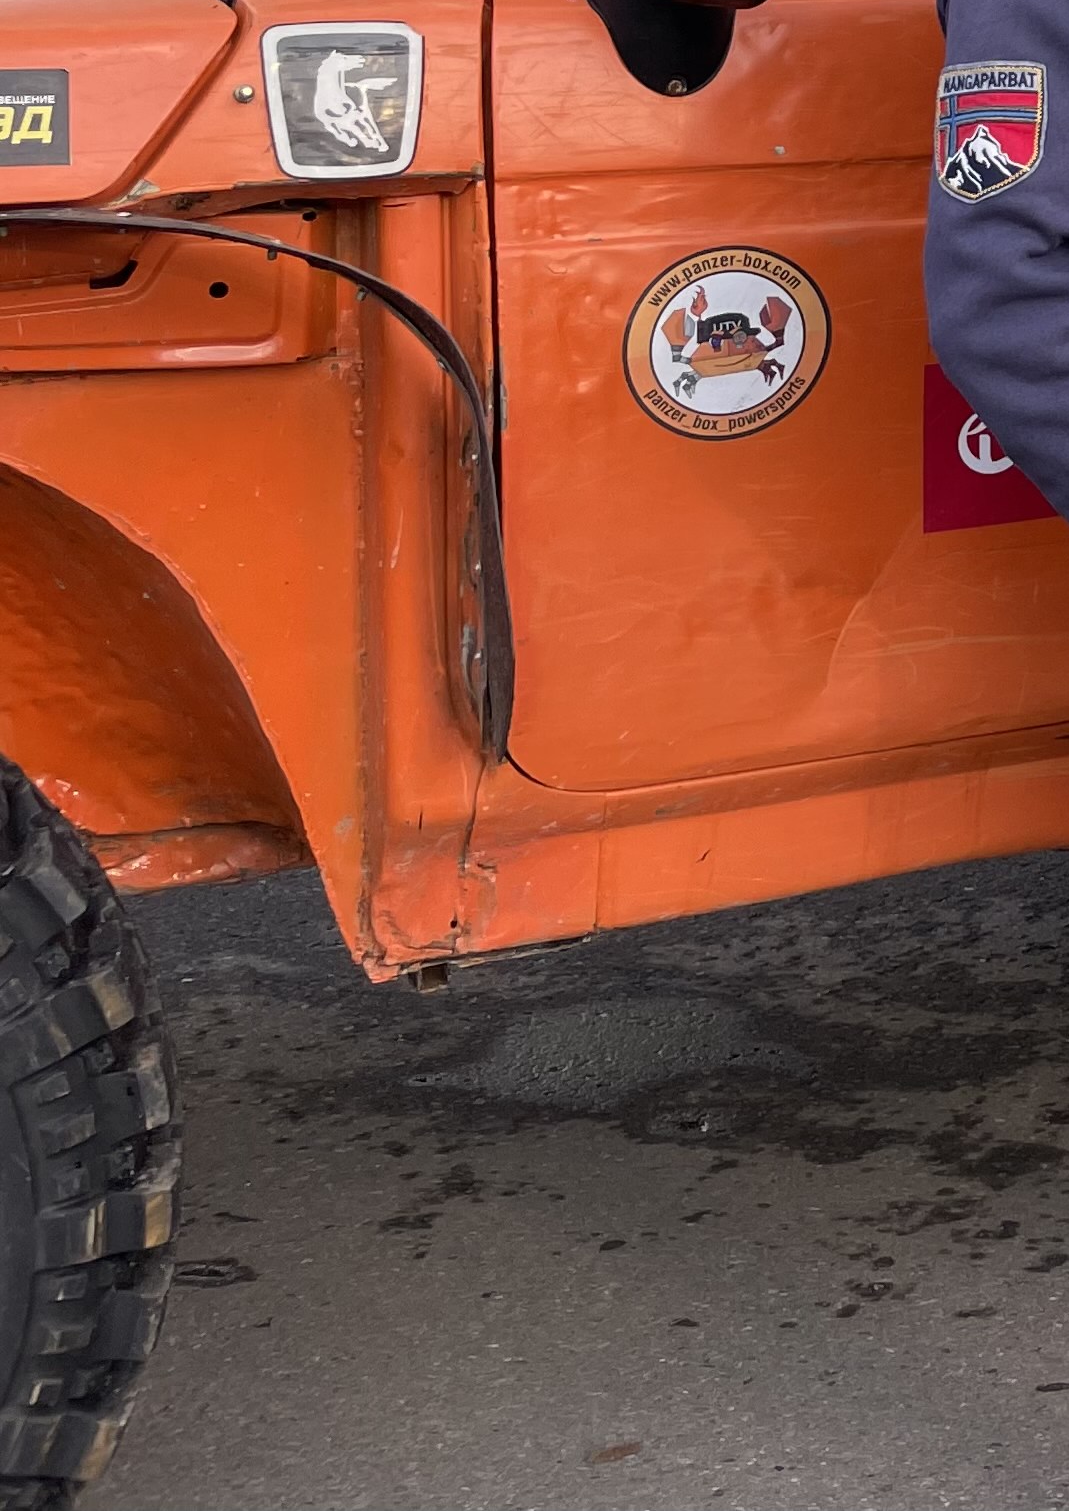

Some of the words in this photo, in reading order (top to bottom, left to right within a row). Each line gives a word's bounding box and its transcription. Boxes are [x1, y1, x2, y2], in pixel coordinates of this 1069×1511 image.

[943, 72, 1037, 93] NANGAPARBAT
[648, 252, 802, 308] www.panzer-box.com
[643, 376, 806, 433] panzer_box_powersports
